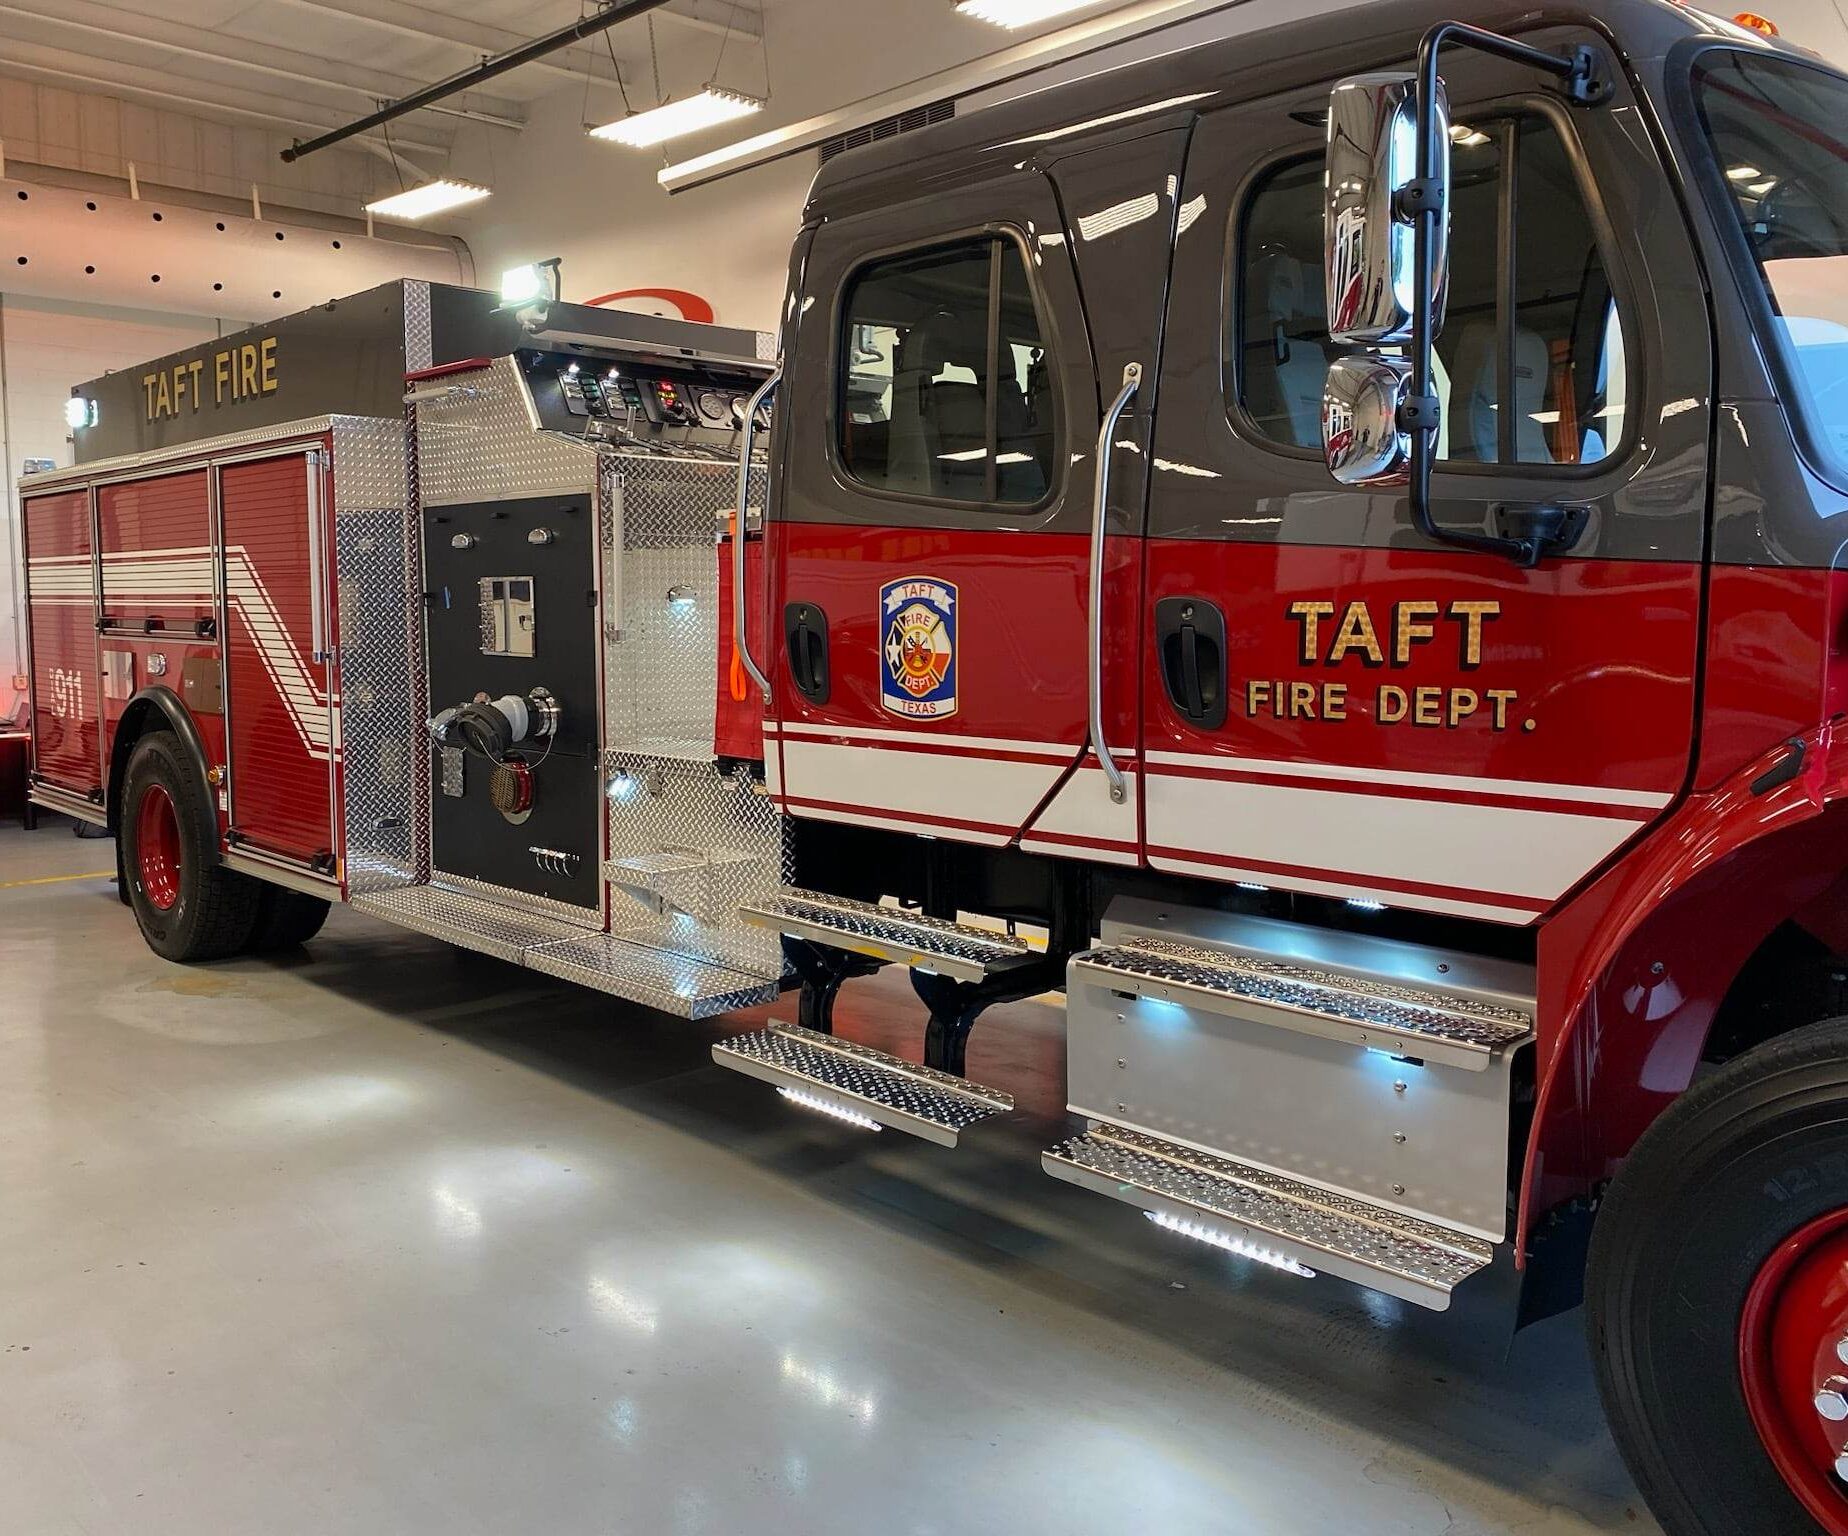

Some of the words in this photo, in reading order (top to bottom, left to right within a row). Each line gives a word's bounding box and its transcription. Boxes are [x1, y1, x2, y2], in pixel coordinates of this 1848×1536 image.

[142, 359, 203, 420] TAFT
[215, 336, 278, 403] FIRE
[902, 584, 935, 598] TAFT
[904, 613, 931, 627] FIRE
[1288, 600, 1501, 667] TAFT
[55, 668, 83, 720] 911
[904, 674, 935, 690] DEPT.
[901, 700, 937, 714] TEXAS
[1248, 680, 1348, 720] FIRE
[1378, 685, 1537, 730] DEPT.
